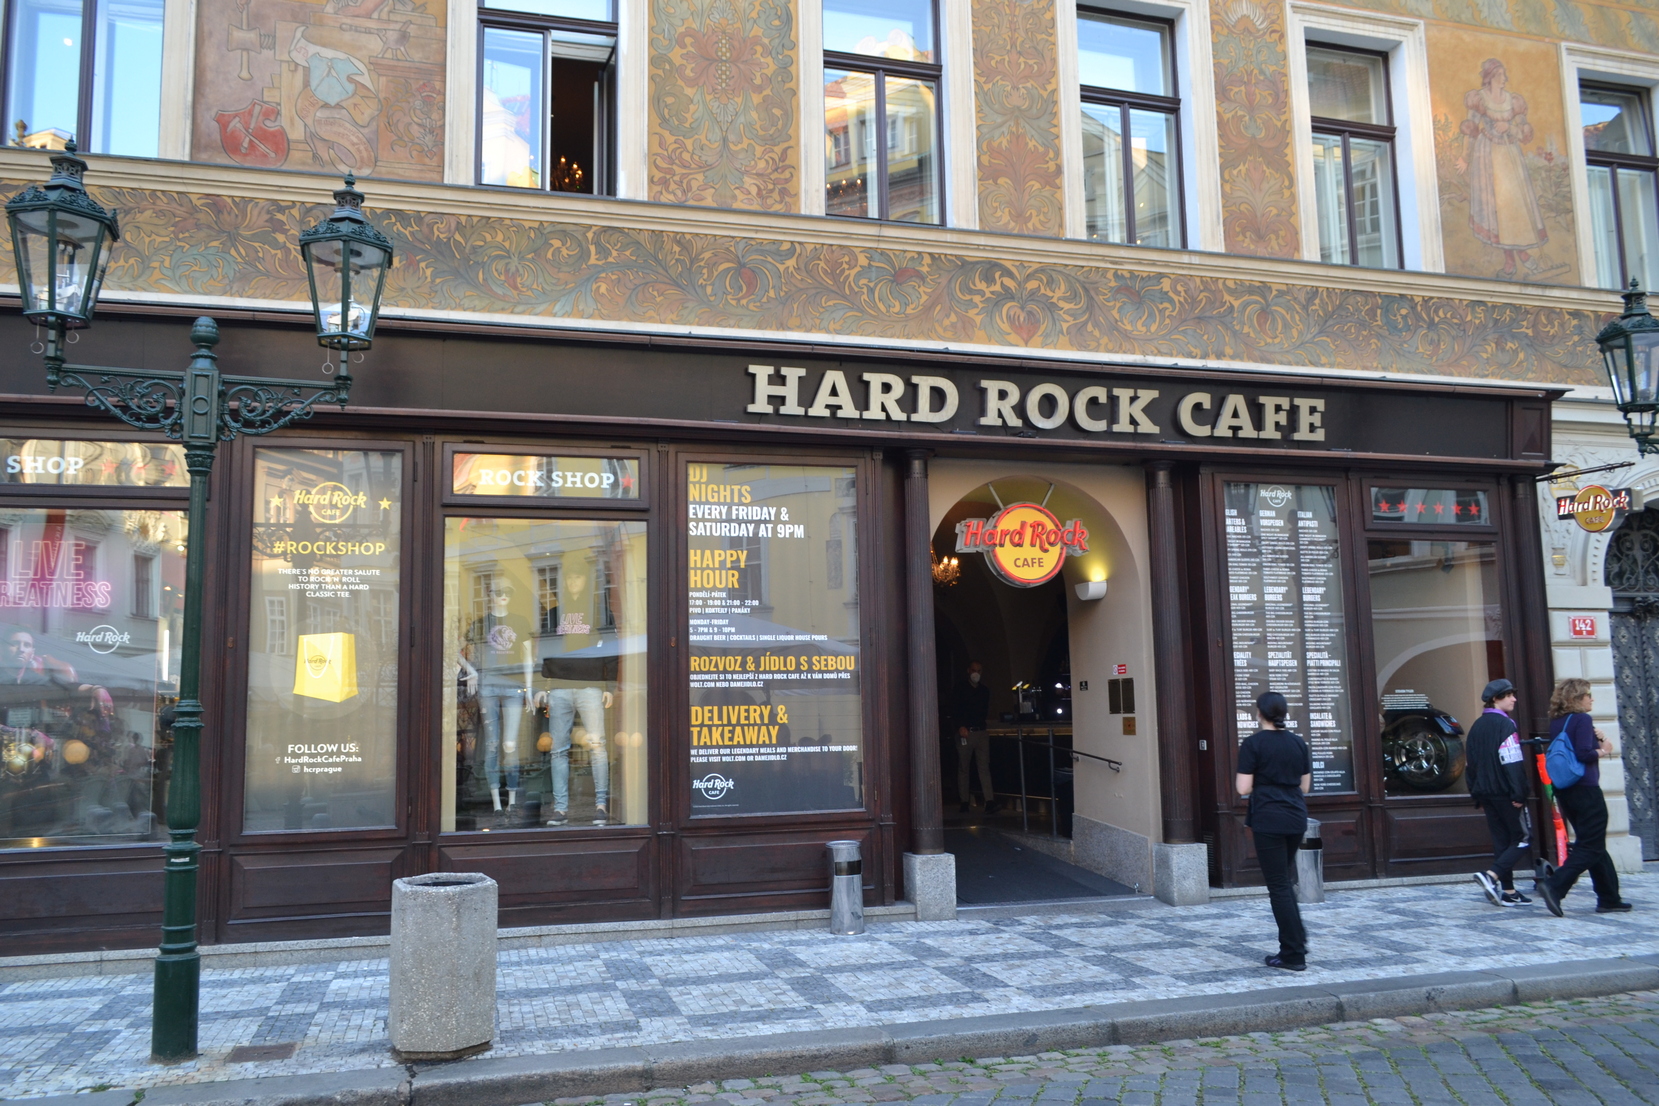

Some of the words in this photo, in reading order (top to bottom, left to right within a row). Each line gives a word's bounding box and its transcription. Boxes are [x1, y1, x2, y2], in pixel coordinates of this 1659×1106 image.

[746, 364, 959, 423] HARD
[977, 379, 1160, 434] ROCK
[1176, 391, 1326, 442] CAFE
[6, 455, 84, 474] SHOP
[478, 469, 544, 487] ROCK
[552, 471, 615, 489] SHOP
[689, 465, 707, 483] DJ
[294, 490, 332, 505] Hard
[332, 490, 367, 508] Rock
[689, 484, 752, 503] NIGHTS
[1260, 489, 1276, 498] Hard
[1276, 490, 1292, 500] Rock
[1558, 494, 1593, 516] Hard
[1593, 490, 1630, 514] Rock
[689, 504, 728, 519] EVERY
[732, 506, 776, 521] FRIDAY
[780, 507, 789, 522] &
[689, 522, 754, 538] SATURDAY
[758, 524, 774, 538] AT
[777, 524, 804, 539] 9PM
[960, 519, 1029, 548] Hard
[1029, 519, 1089, 554] Rock
[272, 541, 386, 556] #ROCKSHOP
[12, 540, 86, 579] LIVE
[689, 550, 748, 568] HAPPY
[1014, 557, 1044, 568] CAFE
[690, 570, 740, 588] HOUR
[1575, 620, 1592, 630] 142
[76, 632, 105, 642] Hard
[105, 632, 131, 644] Rock
[690, 656, 742, 671] ROZVOZ
[746, 656, 755, 671] &
[759, 652, 796, 671] JÍDLO
[800, 655, 808, 670] S
[812, 655, 855, 670] SEBOU
[691, 705, 772, 725] DELIVERY
[776, 705, 789, 724] &
[691, 726, 779, 746] TAKEAWAY
[288, 744, 339, 753] FOLLOW
[340, 743, 359, 753] US:
[284, 756, 362, 764] HardRockCafePraha
[304, 765, 342, 774] hcrprague
[692, 779, 714, 789] Hard
[714, 778, 734, 790] Rock
